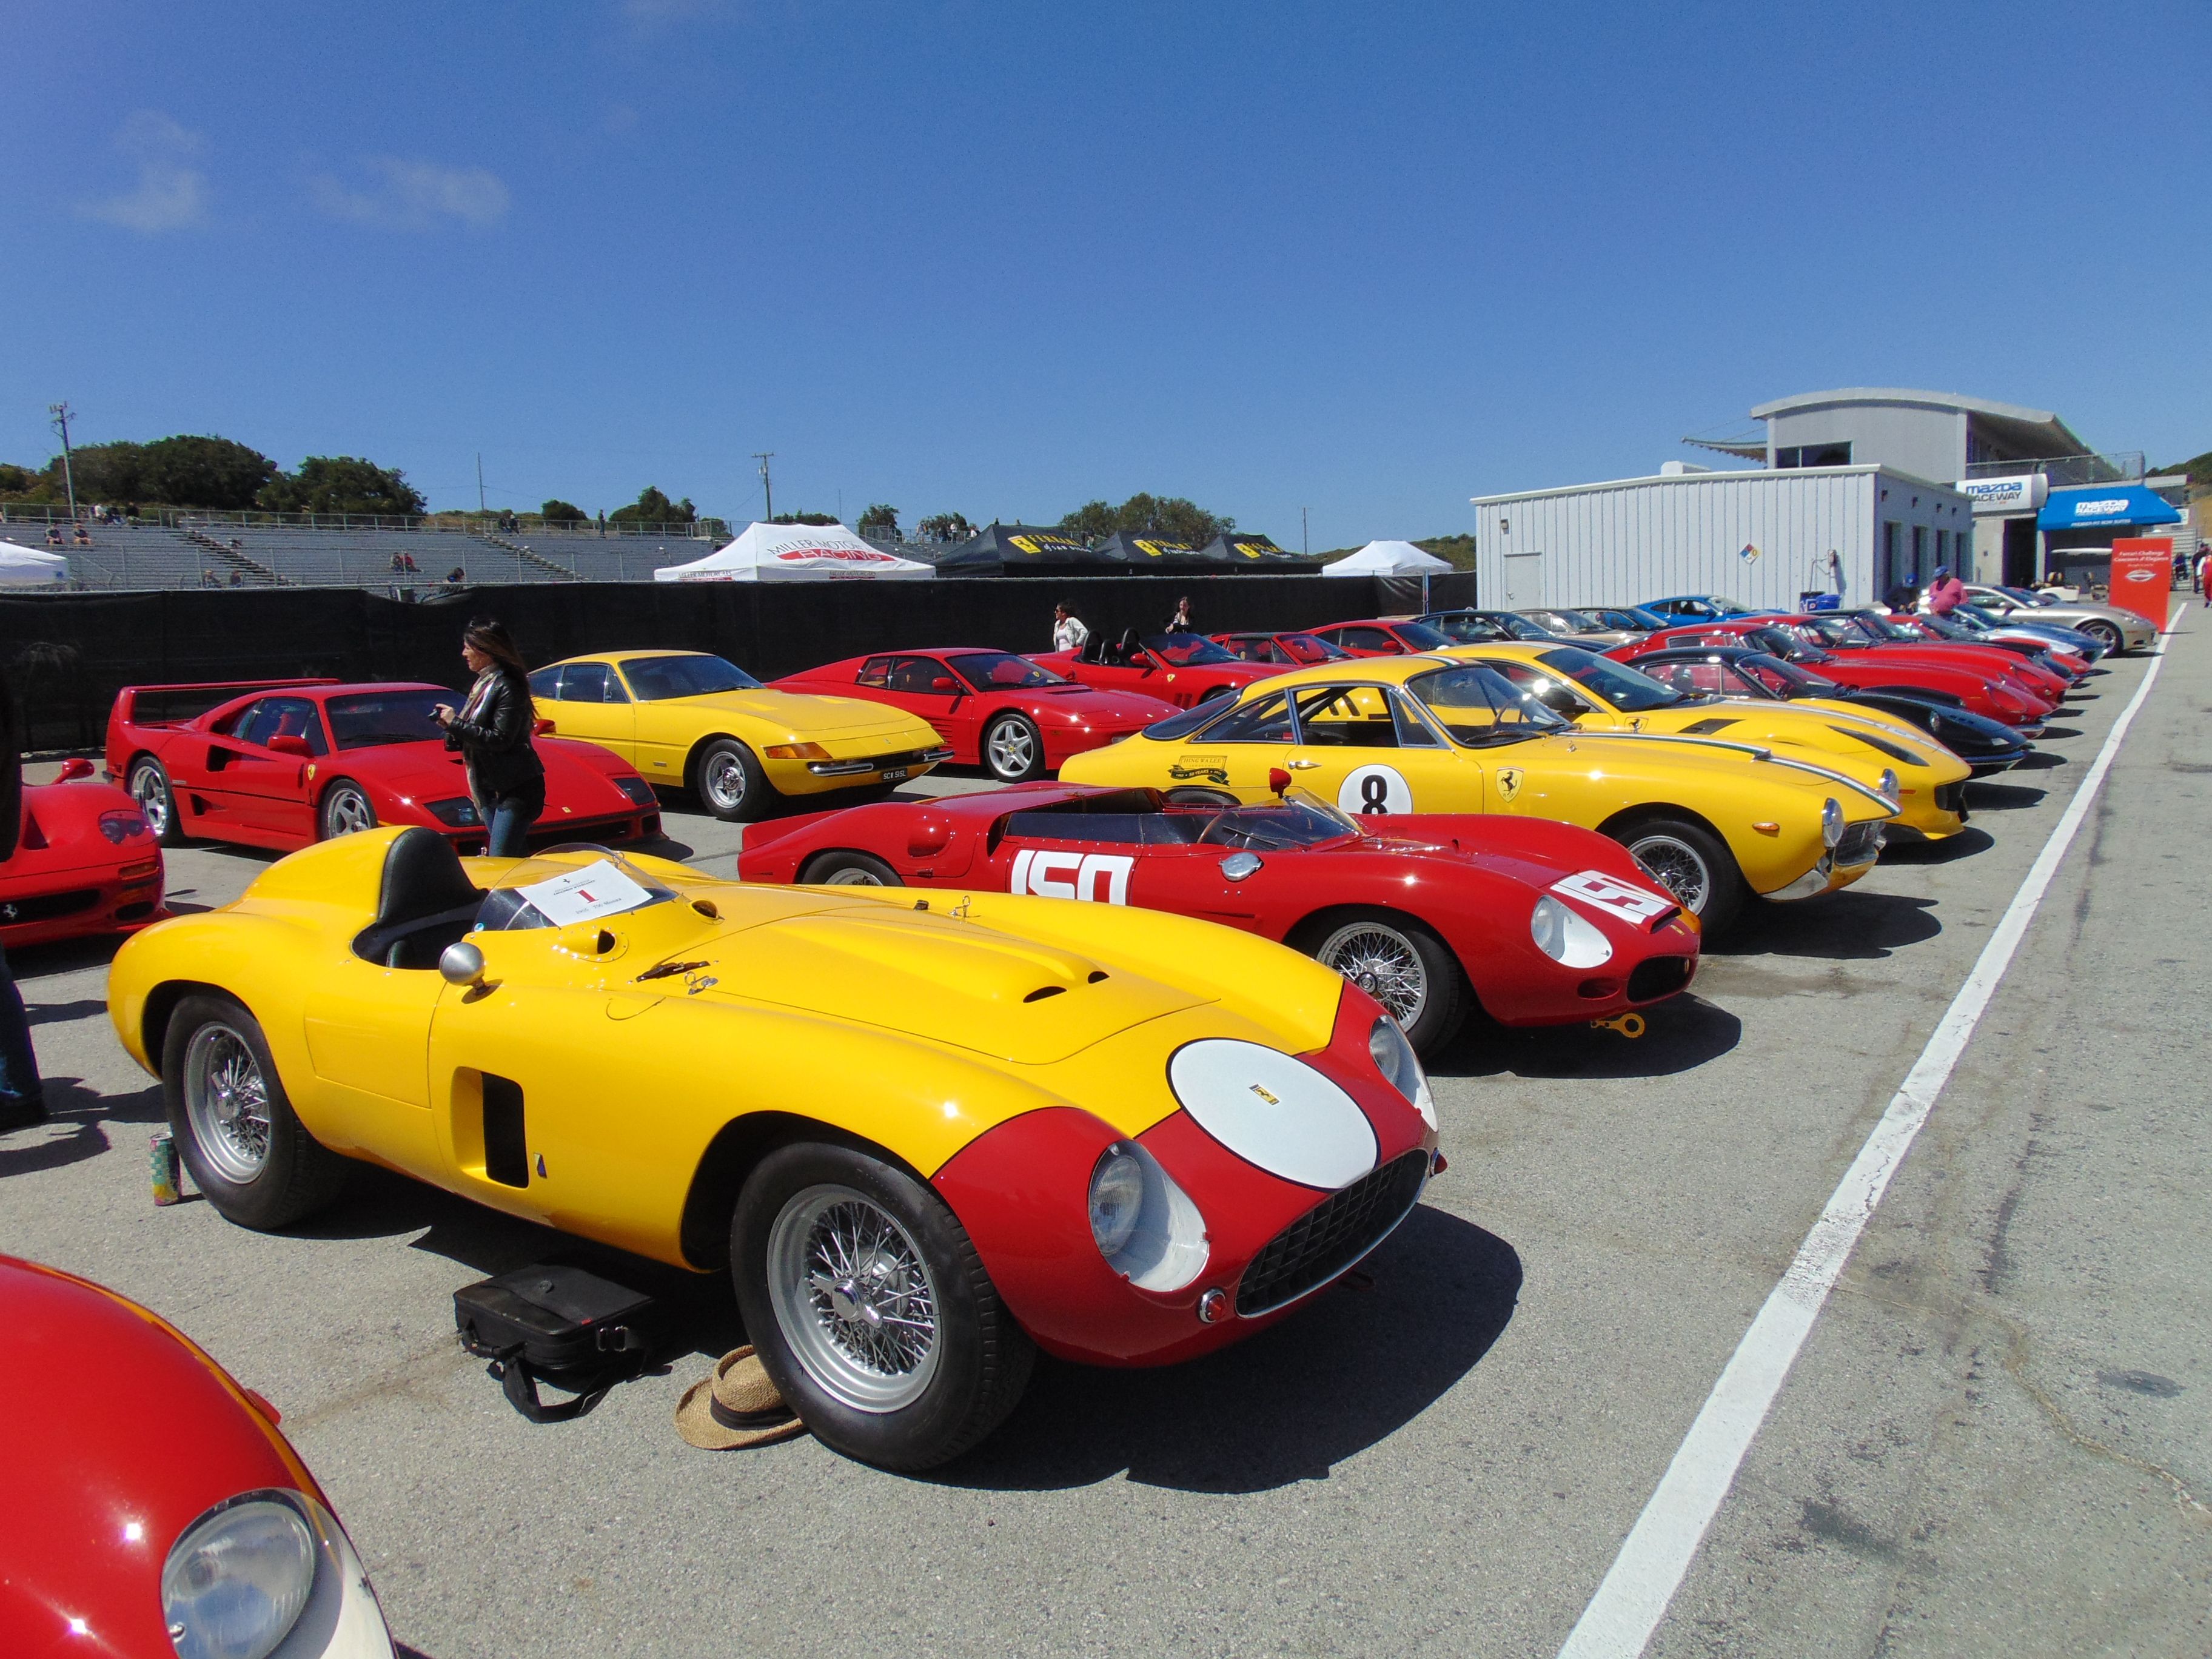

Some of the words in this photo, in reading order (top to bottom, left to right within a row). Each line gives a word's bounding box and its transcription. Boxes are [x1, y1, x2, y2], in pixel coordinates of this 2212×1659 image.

[1973, 492, 2021, 502] ACEWAY
[767, 539, 817, 554] MILLER
[798, 549, 881, 560] RACING
[1361, 774, 1388, 814] 8
[1011, 850, 1134, 906] 150
[574, 889, 599, 903] 1
